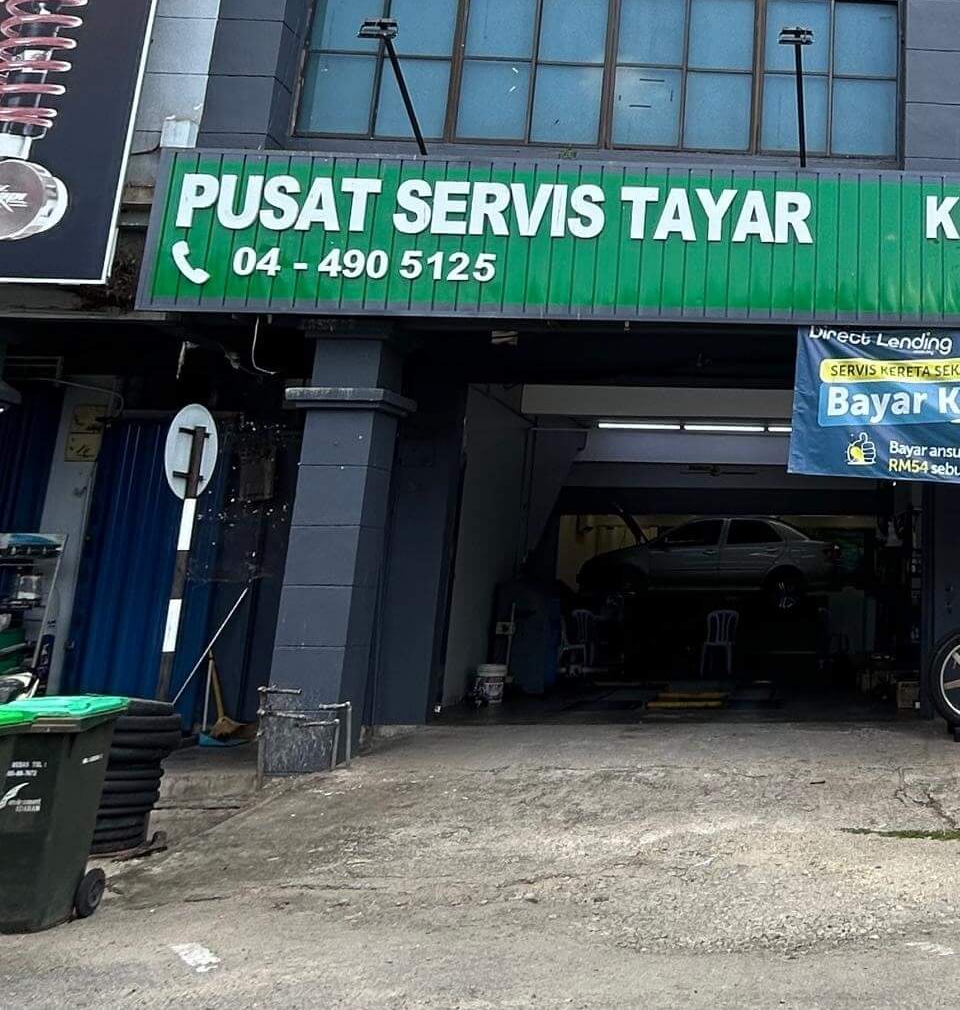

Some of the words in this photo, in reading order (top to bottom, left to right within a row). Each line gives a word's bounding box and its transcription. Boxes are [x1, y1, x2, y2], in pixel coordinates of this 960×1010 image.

[175, 173, 382, 232] PUSAT
[392, 178, 606, 239] SERVIS
[621, 186, 814, 244] TAYAR
[232, 247, 281, 276] 04
[318, 248, 389, 280] 490
[399, 250, 497, 282] 5125
[876, 332, 953, 355] Lending
[830, 363, 877, 378] SERVIS
[880, 364, 931, 378] KERETA
[827, 386, 928, 424] Bayar
[889, 440, 928, 461] Bayar
[889, 461, 929, 474] RM54
